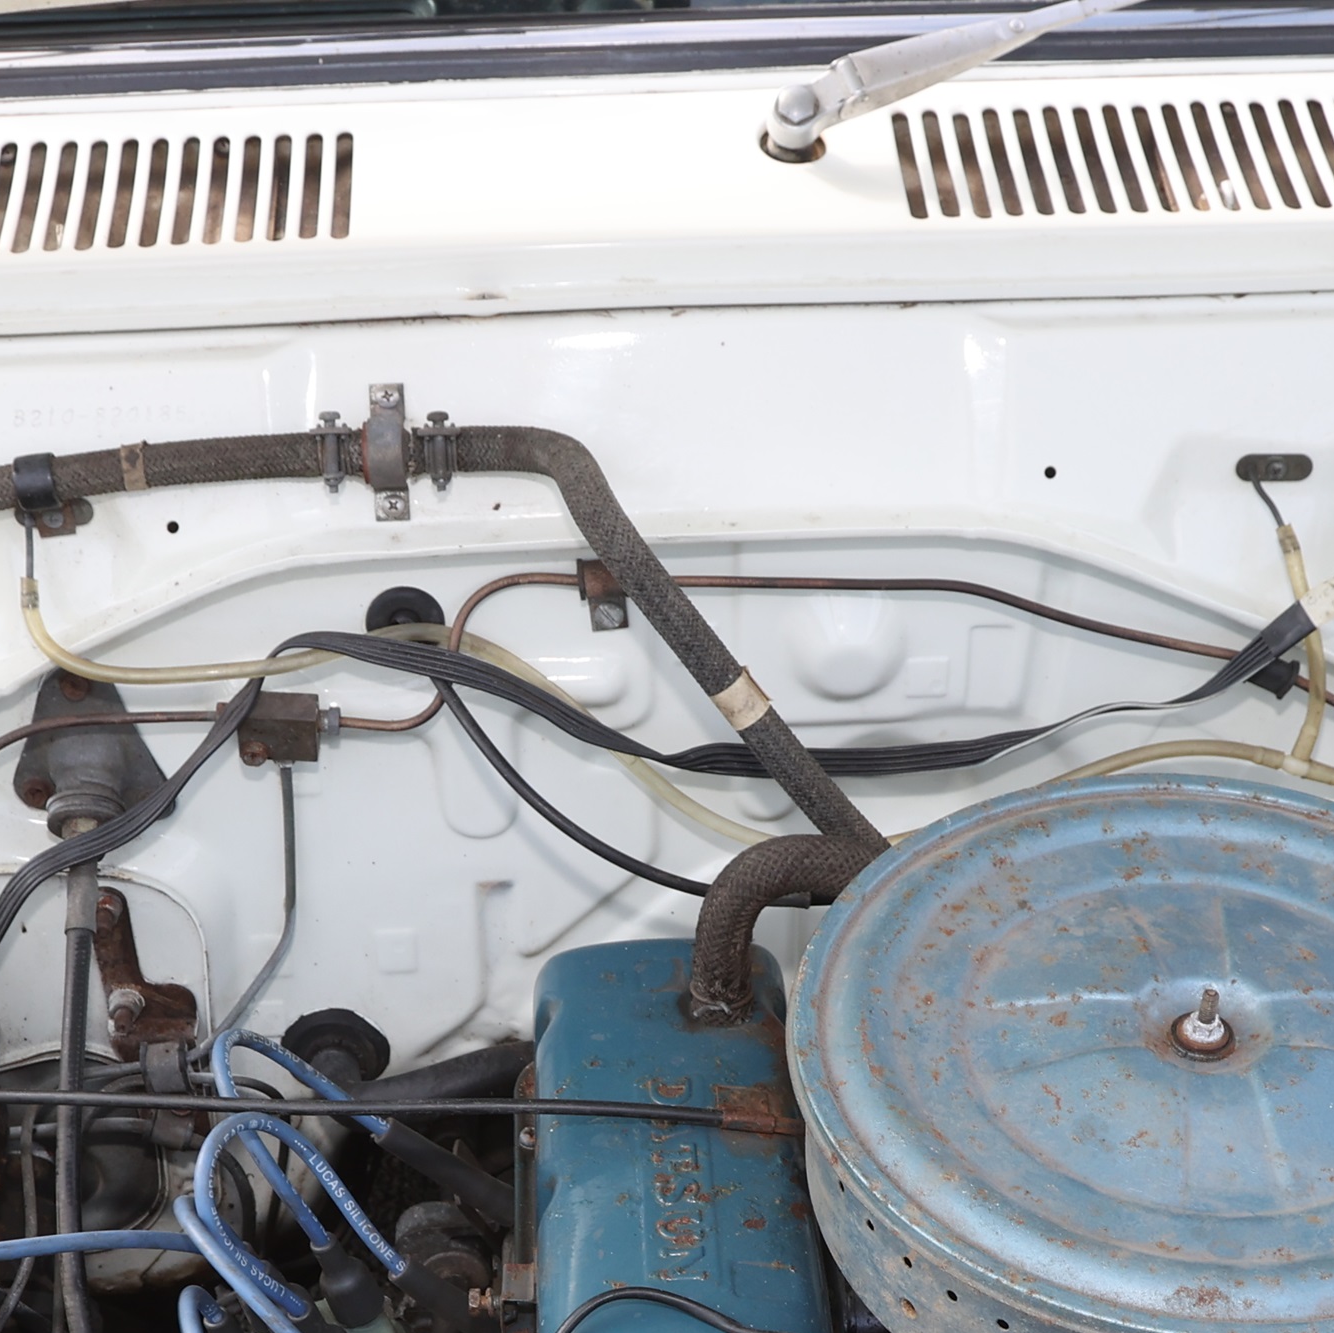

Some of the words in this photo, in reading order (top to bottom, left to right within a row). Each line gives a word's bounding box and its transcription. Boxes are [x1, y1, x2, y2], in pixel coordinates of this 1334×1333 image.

[308, 1153, 345, 1199] LUCAS
[343, 1200, 395, 1261] SILICONE
[250, 1265, 286, 1297] LUCAS
